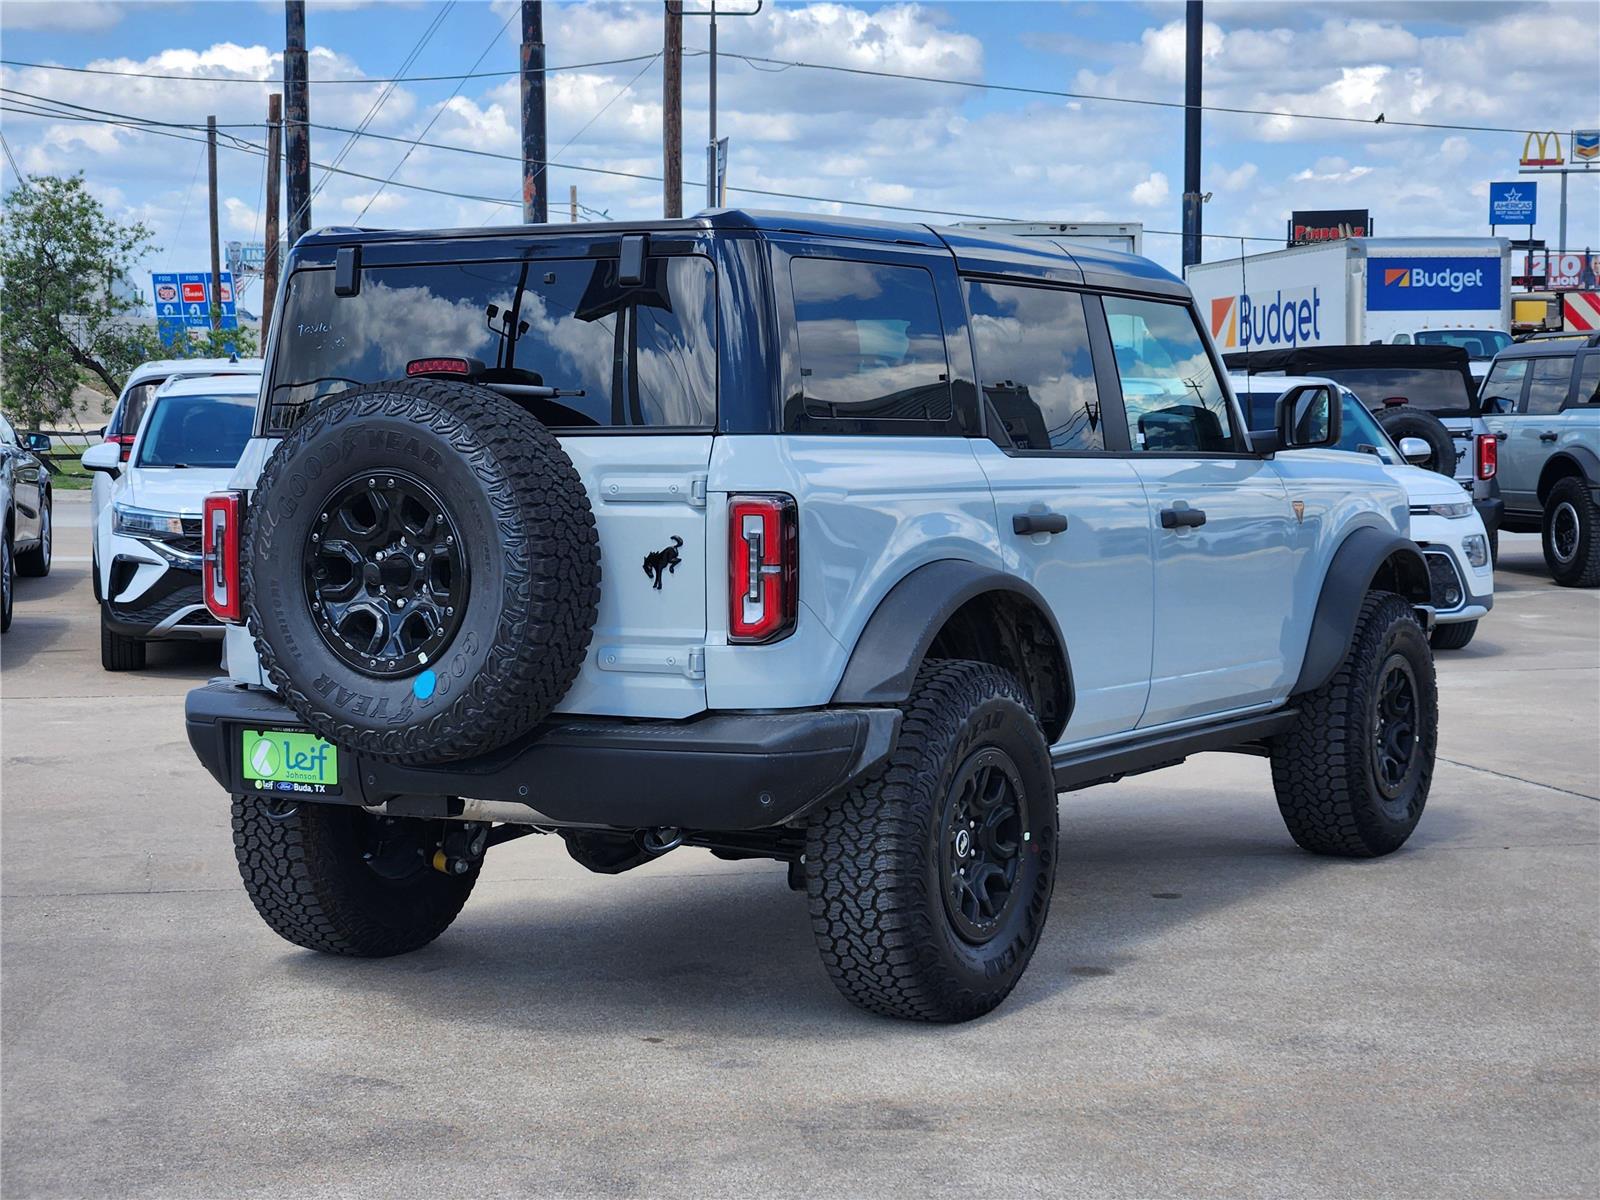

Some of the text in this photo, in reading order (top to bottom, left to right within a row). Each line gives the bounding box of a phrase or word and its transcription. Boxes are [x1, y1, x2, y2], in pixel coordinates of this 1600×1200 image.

[1532, 255, 1581, 277] 210
[1411, 268, 1483, 293] Budget
[1548, 276, 1579, 286] LION
[1239, 287, 1320, 348] Budget
[285, 771, 317, 780] Johnson
[293, 783, 314, 793] Buda,
[314, 784, 326, 793] TX
